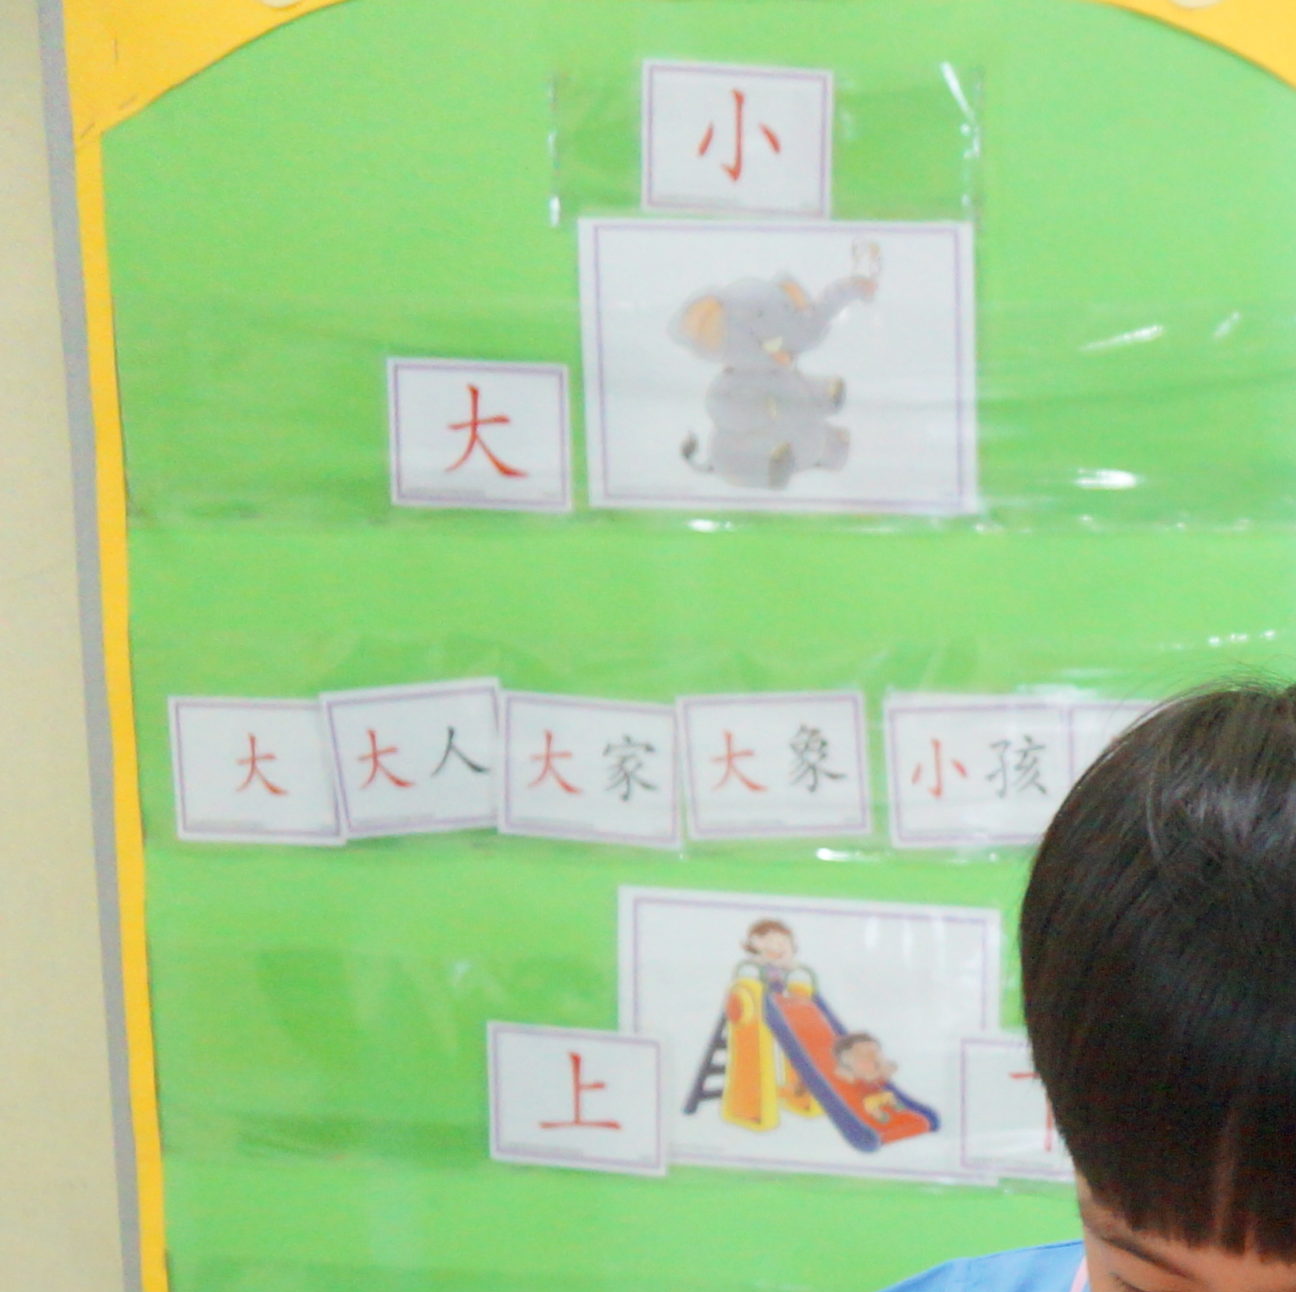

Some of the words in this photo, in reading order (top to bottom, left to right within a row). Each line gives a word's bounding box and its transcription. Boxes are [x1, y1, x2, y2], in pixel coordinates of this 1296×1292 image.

[698, 88, 782, 183] 小
[446, 384, 528, 478] 大
[236, 734, 289, 796] 大
[357, 728, 490, 790] 大人
[529, 731, 659, 799] 大家
[711, 724, 846, 794] 大象
[911, 735, 1049, 800] 小孩
[539, 1051, 621, 1130] 上
